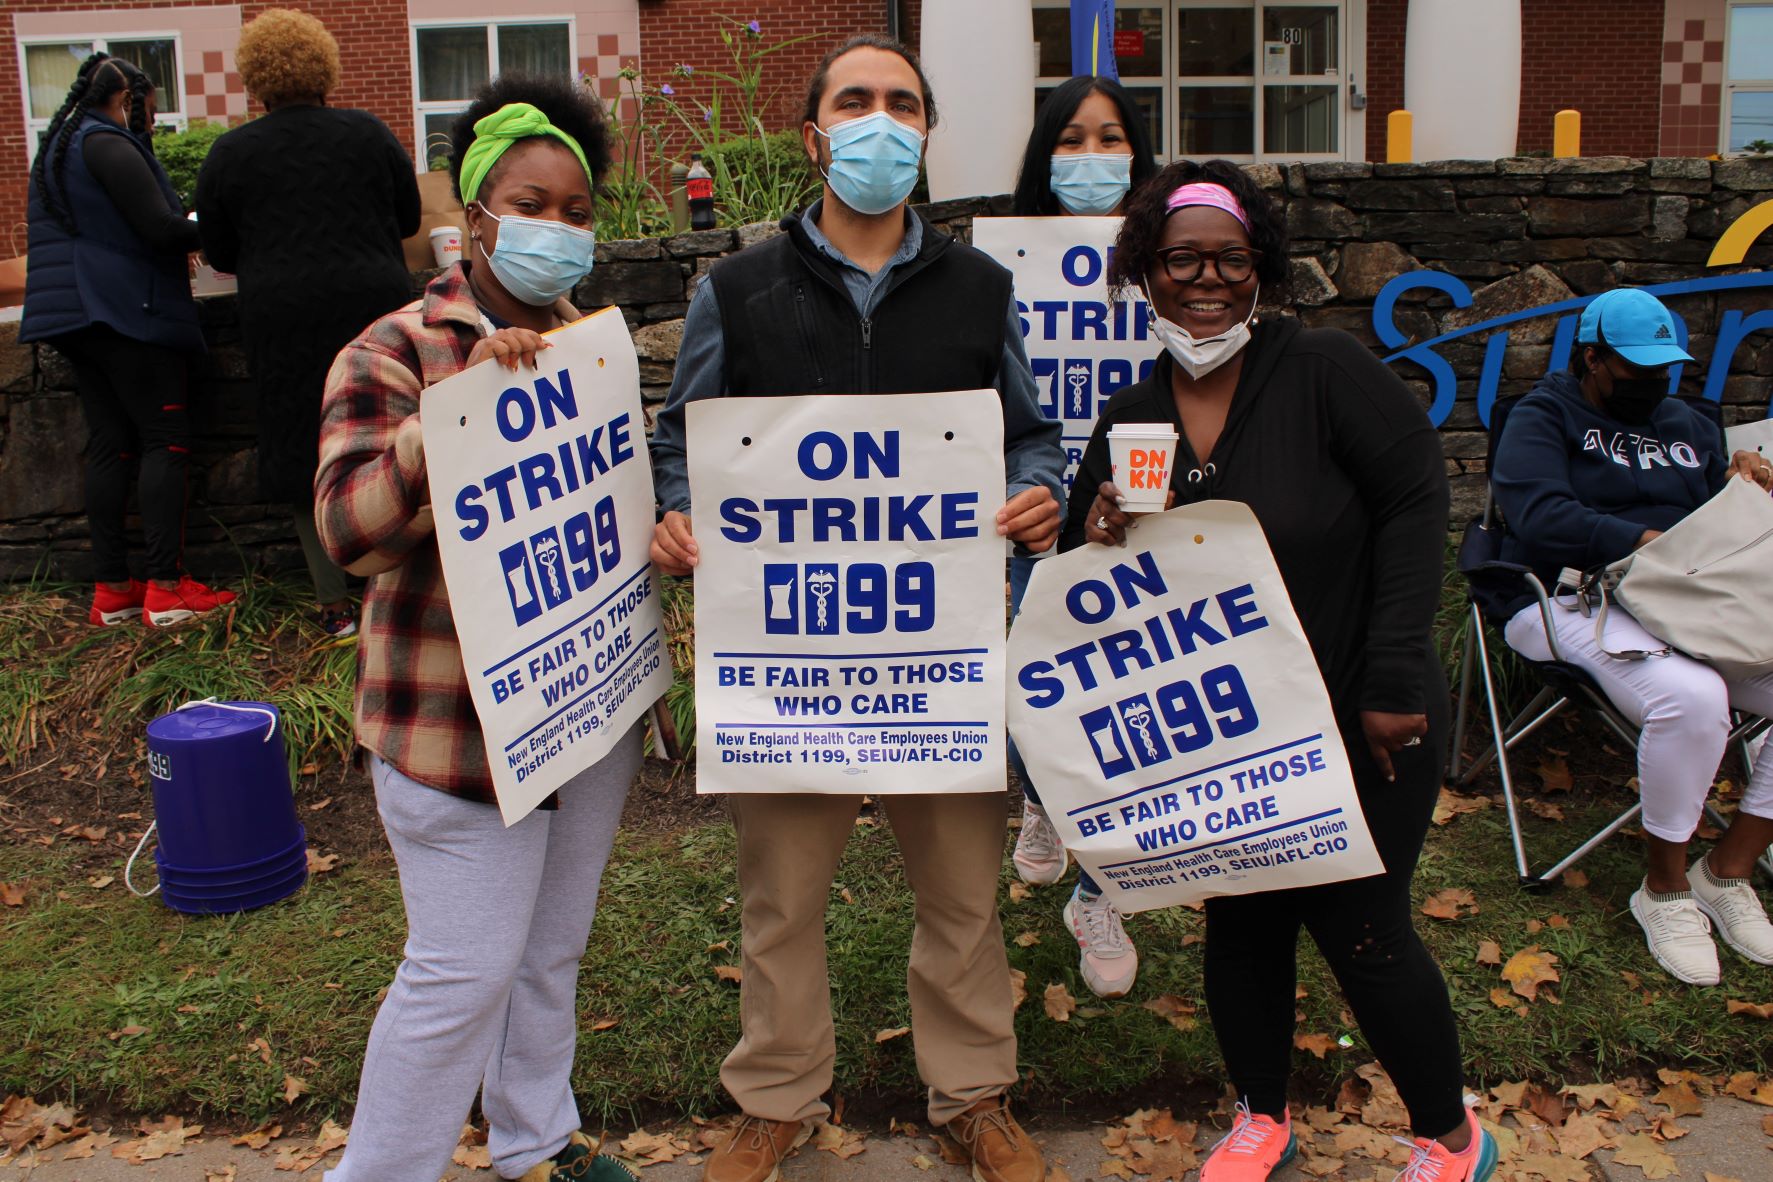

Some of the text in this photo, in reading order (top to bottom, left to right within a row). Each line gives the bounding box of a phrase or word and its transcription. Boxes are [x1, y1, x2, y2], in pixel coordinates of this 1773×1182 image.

[1284, 28, 1300, 44] 80
[496, 369, 578, 442] ON
[455, 412, 634, 541] STRIKE
[798, 431, 899, 481] ON
[1130, 449, 1166, 469] DN
[720, 492, 978, 543] STRIKE
[1066, 551, 1168, 624] ON
[492, 576, 652, 704] BE FAIR TO THOSE
[542, 626, 632, 708] WHO CARE
[1018, 584, 1269, 708] STRIKE
[508, 639, 660, 768] New England Health Care Employees Union
[719, 662, 983, 687] BE FAIR TO THOSE
[517, 656, 660, 783] District 1199, SEIU/AFL-CIO
[774, 693, 928, 715] WHO CARE
[717, 731, 987, 748] New England Health Care Employees Union
[722, 748, 982, 765] District 1199, SEIU/AFL-CIO
[1077, 749, 1325, 837] BE FAIR TO THOSE
[1103, 821, 1347, 881] New England Health Care Employees Union
[1135, 796, 1279, 852] WHO CARE
[1119, 874, 1177, 891] District
[1180, 865, 1228, 882] 1199,
[1231, 837, 1347, 870] SEIU/AFL-CIO
